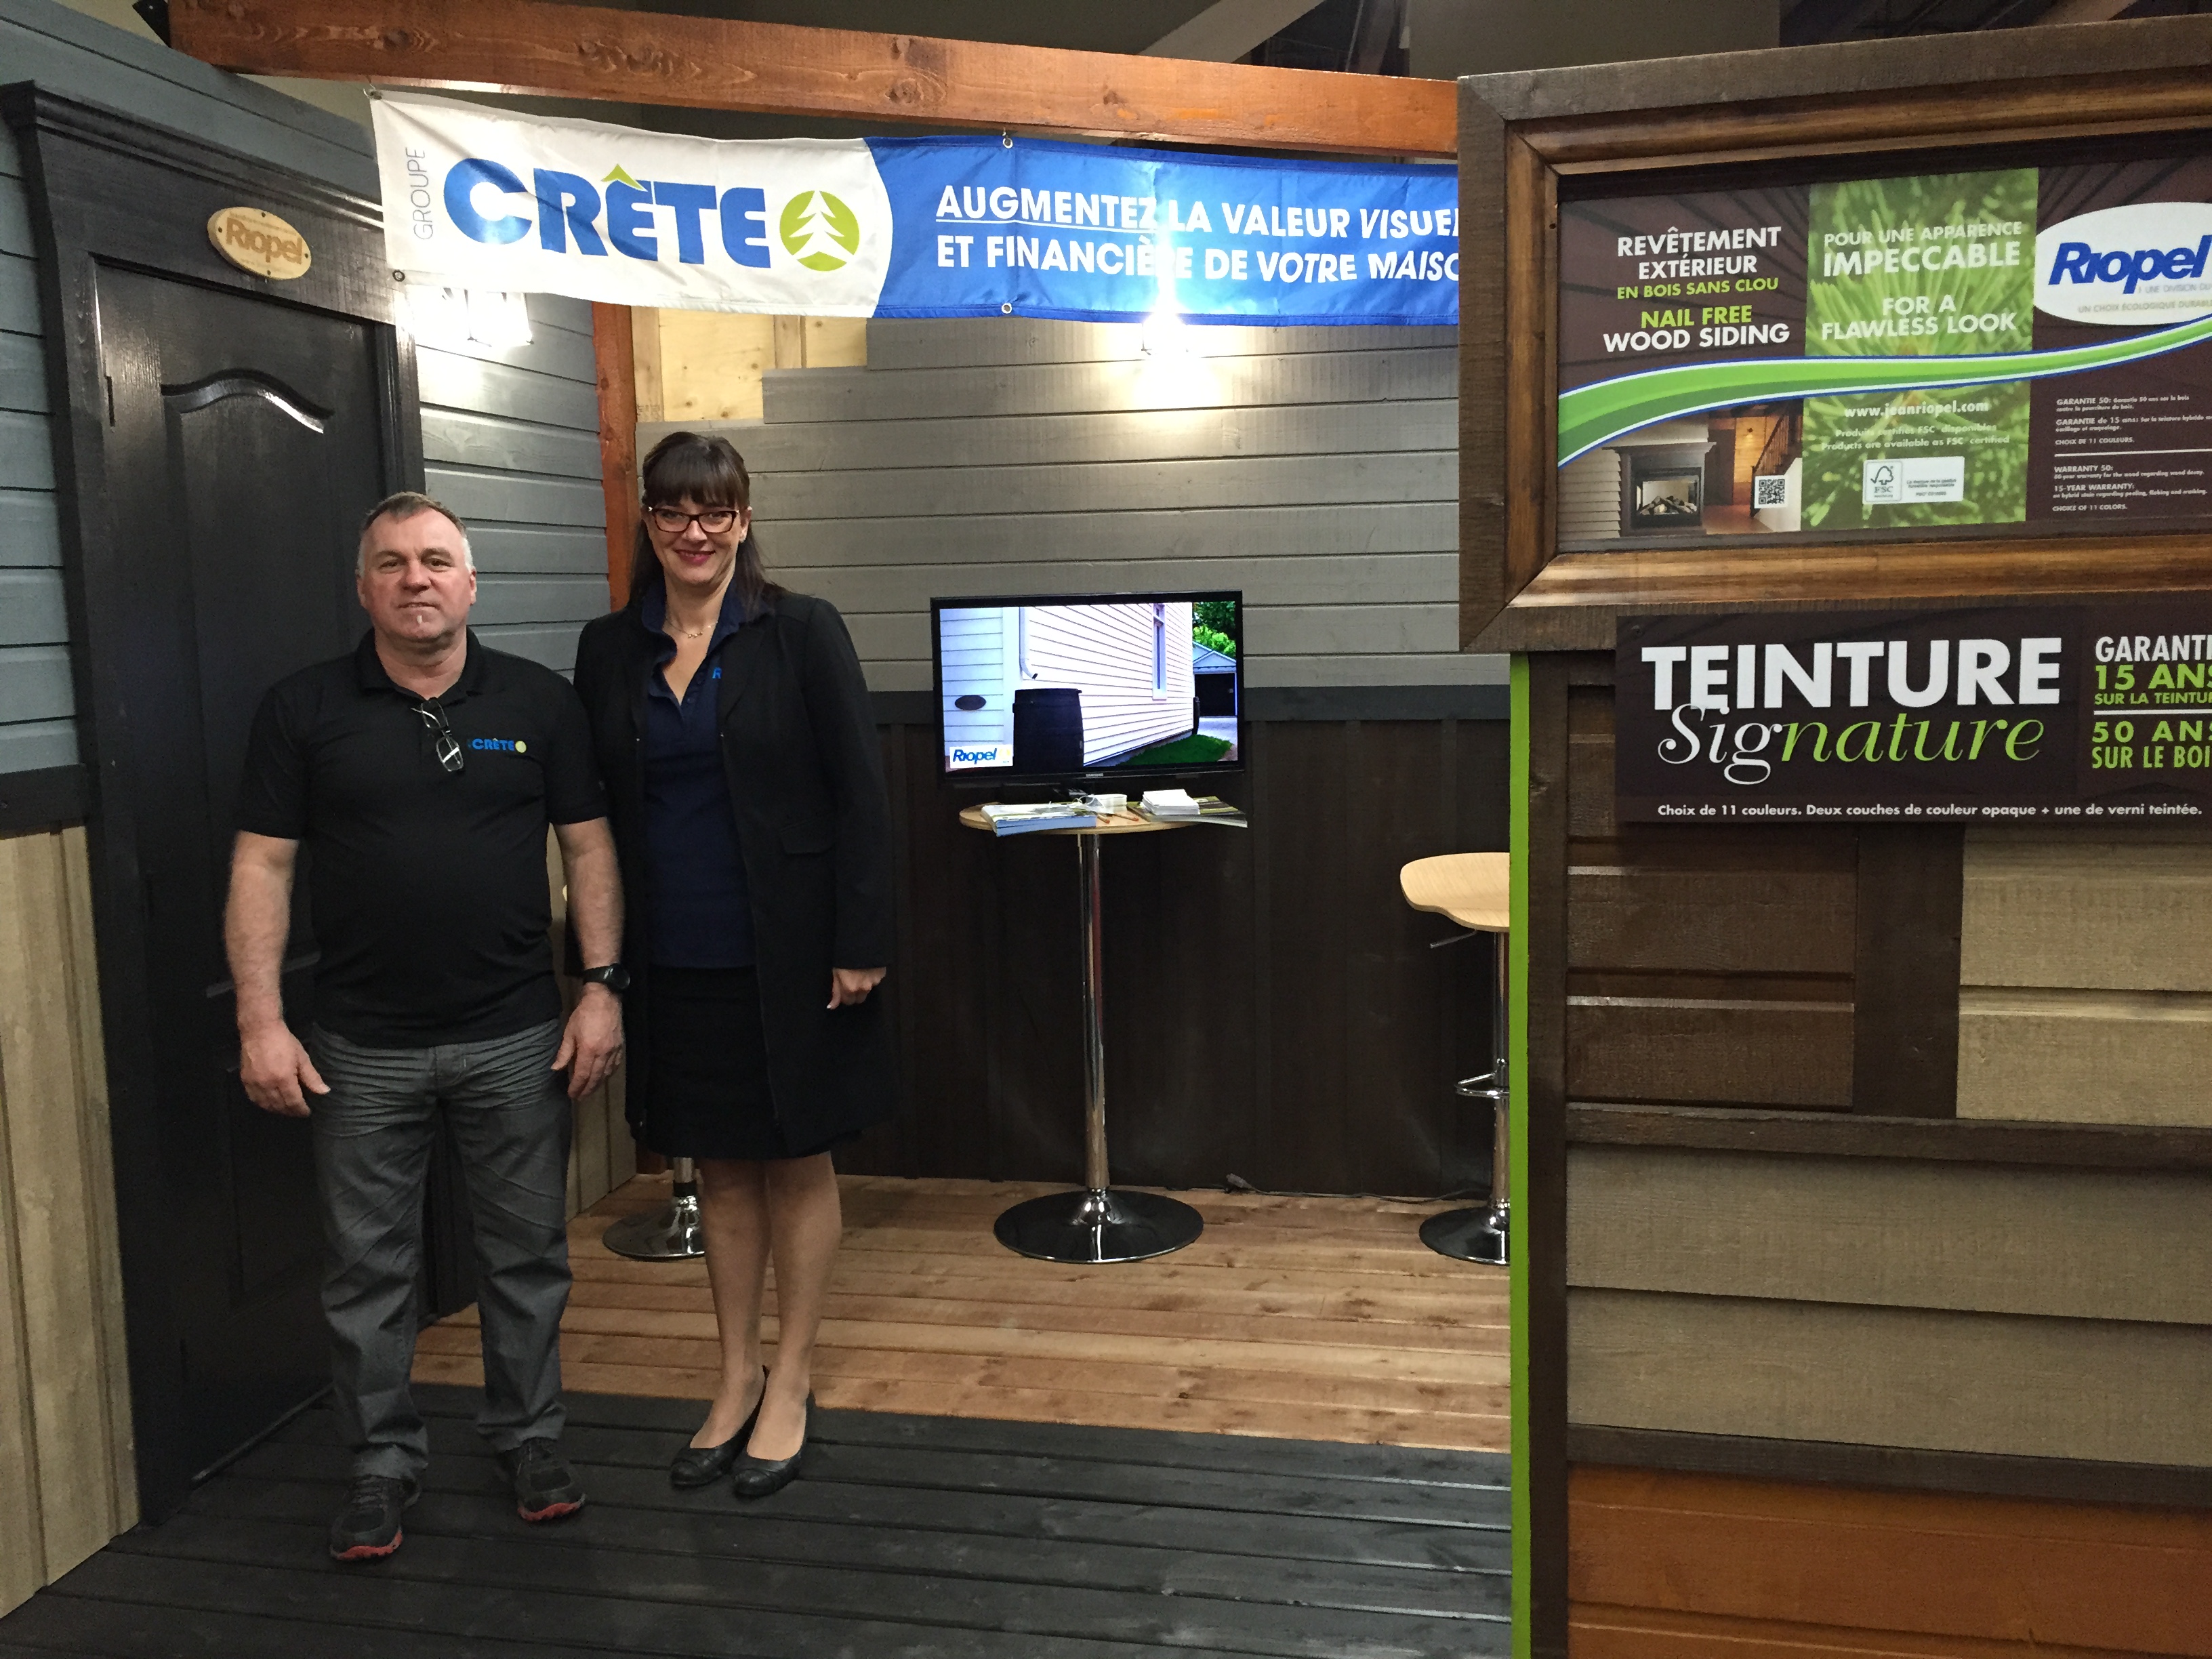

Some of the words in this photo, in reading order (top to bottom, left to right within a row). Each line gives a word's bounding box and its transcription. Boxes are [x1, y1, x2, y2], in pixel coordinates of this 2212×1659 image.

[405, 147, 433, 240] GROUPE
[444, 158, 771, 268] CRÊTE
[936, 185, 1157, 228] AUGMENTEZ
[1168, 199, 1212, 232] LA
[1221, 203, 1350, 238] VALEUR
[1359, 207, 1459, 239] VISUE
[226, 217, 302, 264] Riopel
[1618, 226, 1782, 257] REVÊTEMENT
[1824, 230, 1872, 247] POUR
[1879, 228, 1914, 243] UNE
[1920, 221, 2022, 241] APPARENCE
[937, 235, 974, 268] ET
[987, 234, 1193, 279] FINANCIÈE
[1205, 248, 1248, 280] DE
[1256, 251, 1357, 283] VOTRE
[1639, 253, 1757, 280] EXTÉRIEUR
[1824, 241, 2020, 277] IMPECCABLE
[2048, 234, 2212, 294] Riopel
[1617, 287, 1639, 300] EN
[1643, 283, 1681, 298] BOIS
[1686, 280, 1730, 295] SANS
[1735, 277, 1779, 292] CLOU
[1641, 308, 1695, 329] NAIL
[1702, 305, 1753, 325] FREE
[1883, 295, 1930, 316] FOR
[1938, 294, 1957, 313] A
[2078, 305, 2091, 313] UN
[2093, 304, 2120, 312] CHOIX
[1603, 329, 1691, 352] WOOD
[1699, 323, 1790, 348] SIDING
[1822, 316, 1938, 340] FLAWLESS
[1948, 312, 2018, 333] LOOK
[1845, 400, 1989, 417] www.jeanriopel.com
[1884, 438, 1929, 448] available
[1946, 437, 1963, 445] FSC
[1917, 425, 1936, 434] FSC
[1641, 637, 2062, 710] TEINTURE
[2095, 664, 2135, 690] 15
[2094, 693, 2125, 705] SUR
[2130, 693, 2149, 704] LA
[472, 738, 514, 751] CRÊTE
[1658, 703, 2044, 785] Signature
[2092, 720, 2135, 743] 50
[2151, 720, 2212, 741] AN
[953, 748, 997, 764] Riopel
[2092, 746, 2133, 769] SUR
[2143, 745, 2164, 768] LE
[1658, 804, 1696, 815] Choix
[1700, 804, 1717, 815] de
[1721, 804, 1736, 815] 11
[1742, 804, 1802, 815] couleurs.
[1806, 804, 1843, 815] Deux
[1846, 804, 1900, 815] couches
[1904, 804, 1922, 815] de
[1926, 803, 1978, 815] couleur
[1982, 805, 2036, 817] opaque
[2041, 806, 2050, 815] +
[2055, 806, 2082, 815] une
[2085, 804, 2104, 815] de
[2108, 804, 2145, 815] verni
[2149, 803, 2203, 815] teintée.
